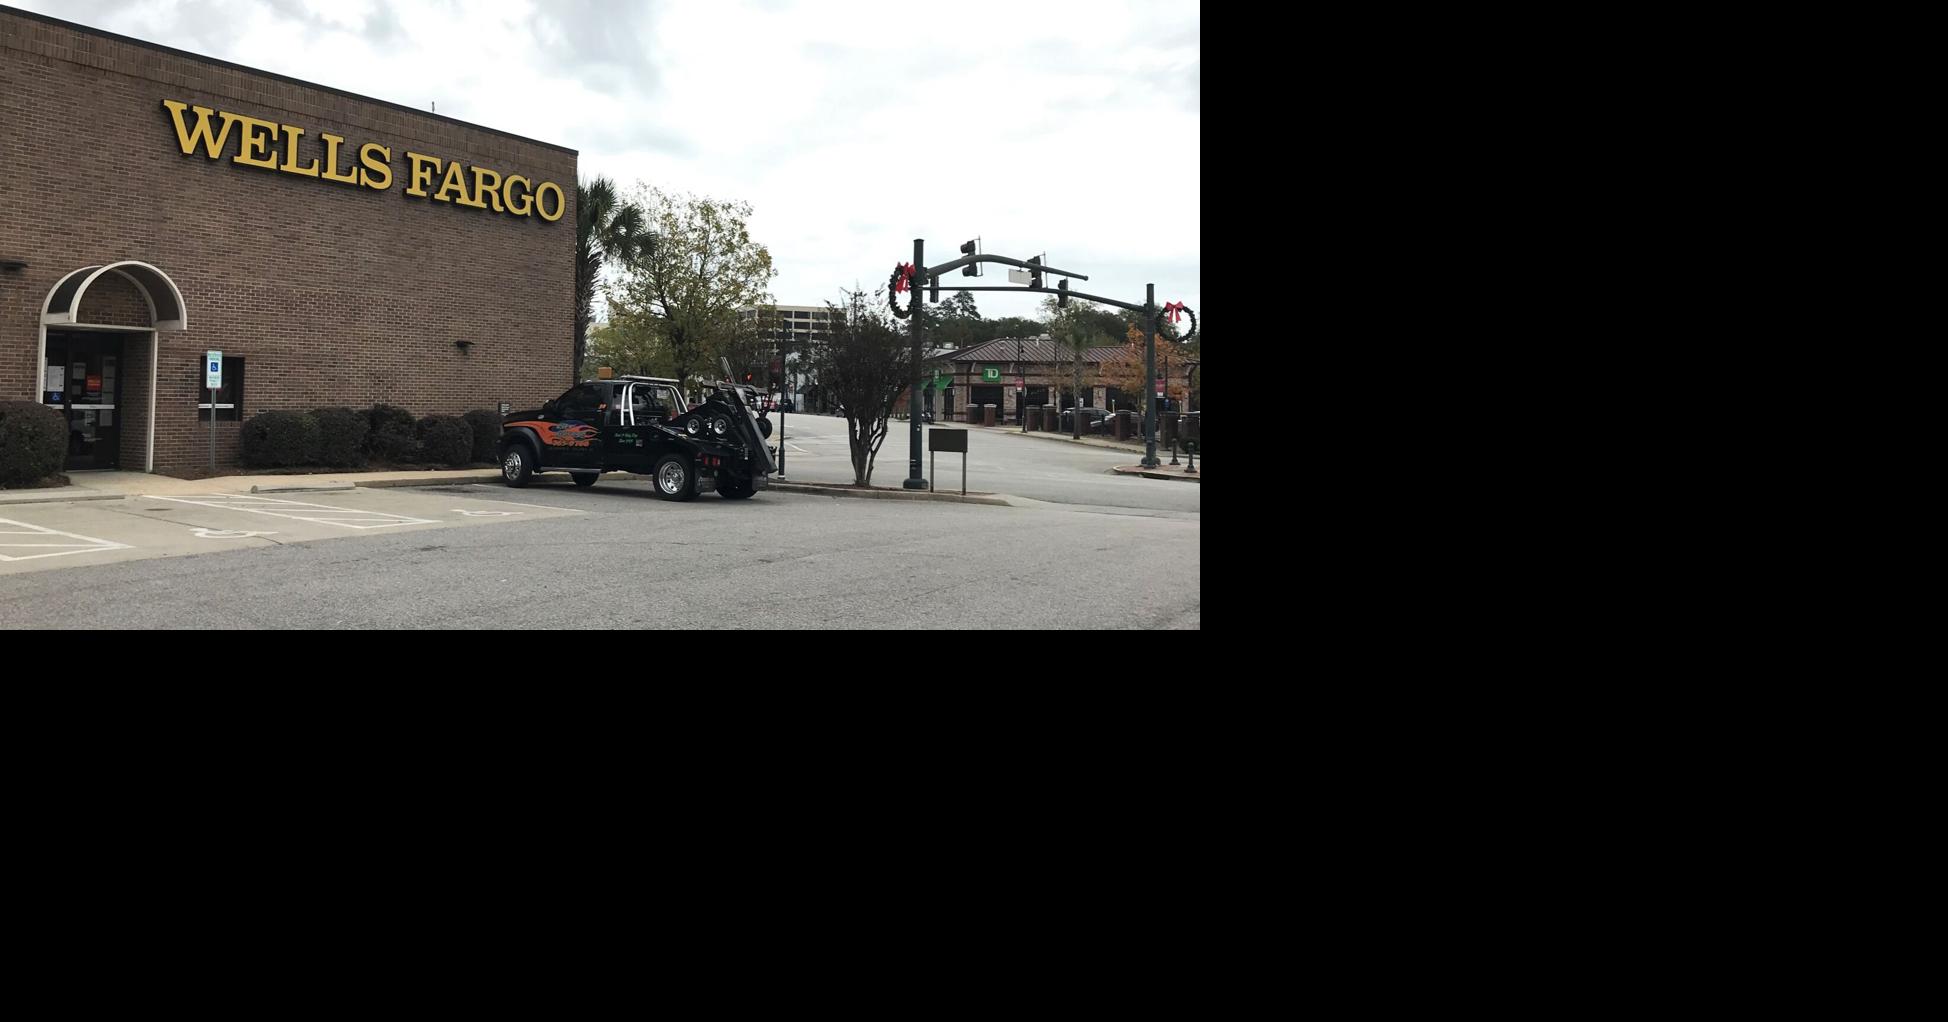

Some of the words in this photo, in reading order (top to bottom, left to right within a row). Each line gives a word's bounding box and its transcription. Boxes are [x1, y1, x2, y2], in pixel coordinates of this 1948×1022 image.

[163, 99, 393, 190] WELLS
[405, 151, 566, 222] FARGO
[984, 368, 999, 379] TD
